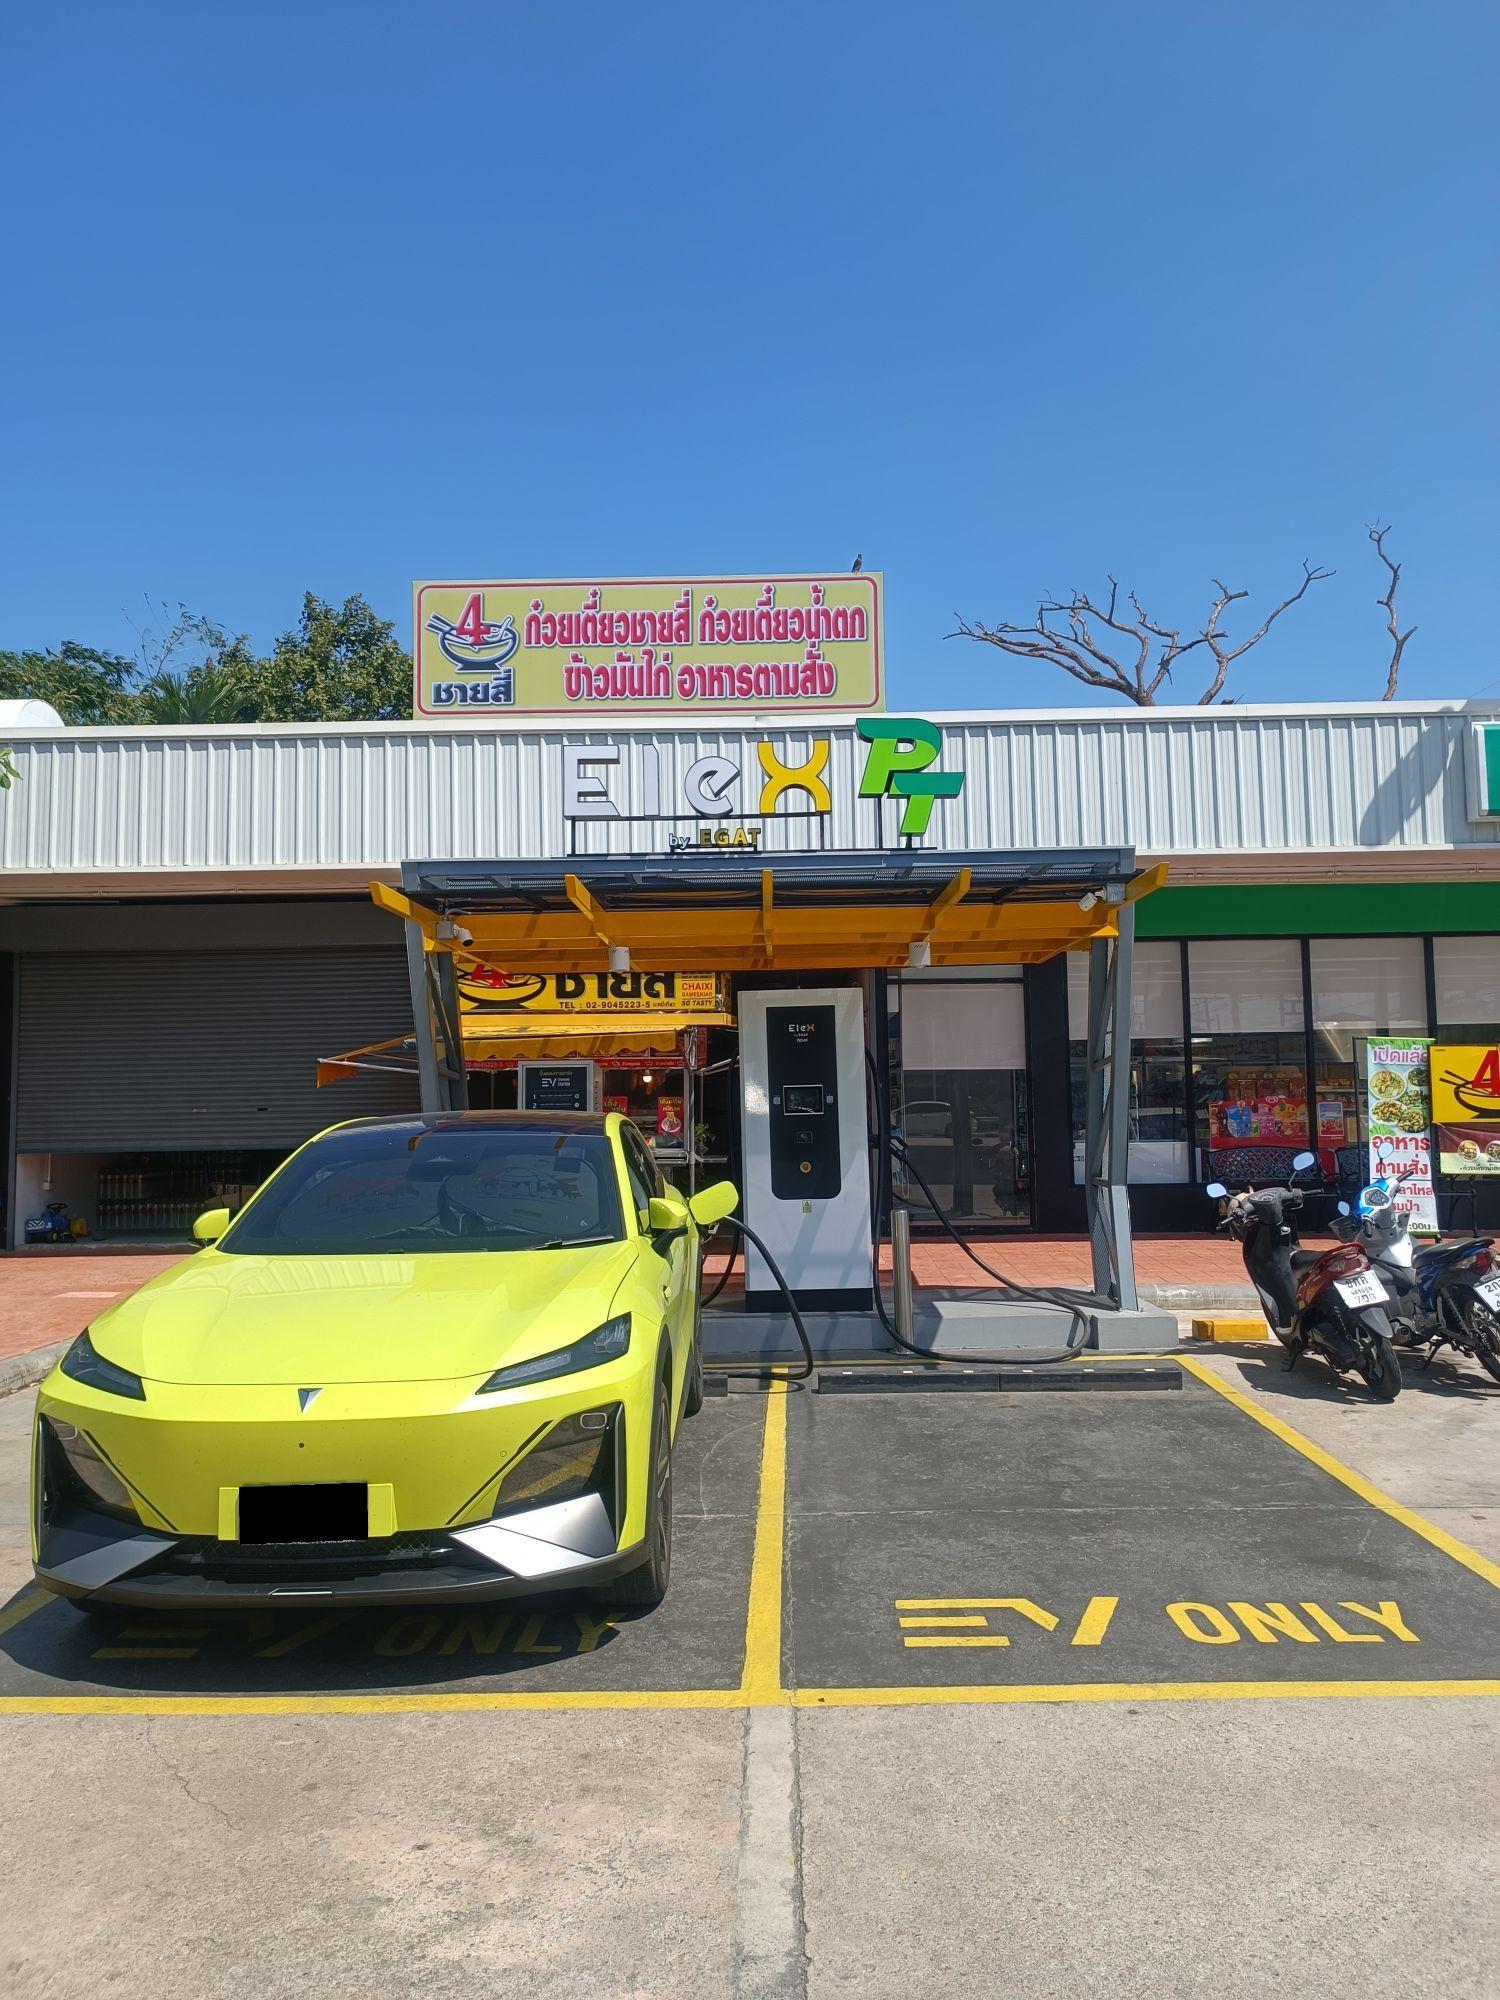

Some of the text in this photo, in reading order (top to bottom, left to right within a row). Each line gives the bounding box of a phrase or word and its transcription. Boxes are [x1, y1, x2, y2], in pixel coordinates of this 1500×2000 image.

[455, 593, 486, 646] 4
[432, 669, 513, 704] ชายสี่
[563, 642, 835, 698] ข้าวมันไก่ อาหารตามสั่ง
[855, 718, 966, 837] PT
[668, 827, 761, 850] by EGAT
[681, 982, 713, 991] CHAIXI
[692, 999, 713, 1007] TASTY
[558, 1001, 576, 1009] TEL
[586, 1001, 651, 1009] 02-9045223-5
[541, 1077, 557, 1087] EV
[372, 1612, 628, 1657] ONLY
[896, 1596, 1421, 1648] EV ONLY
